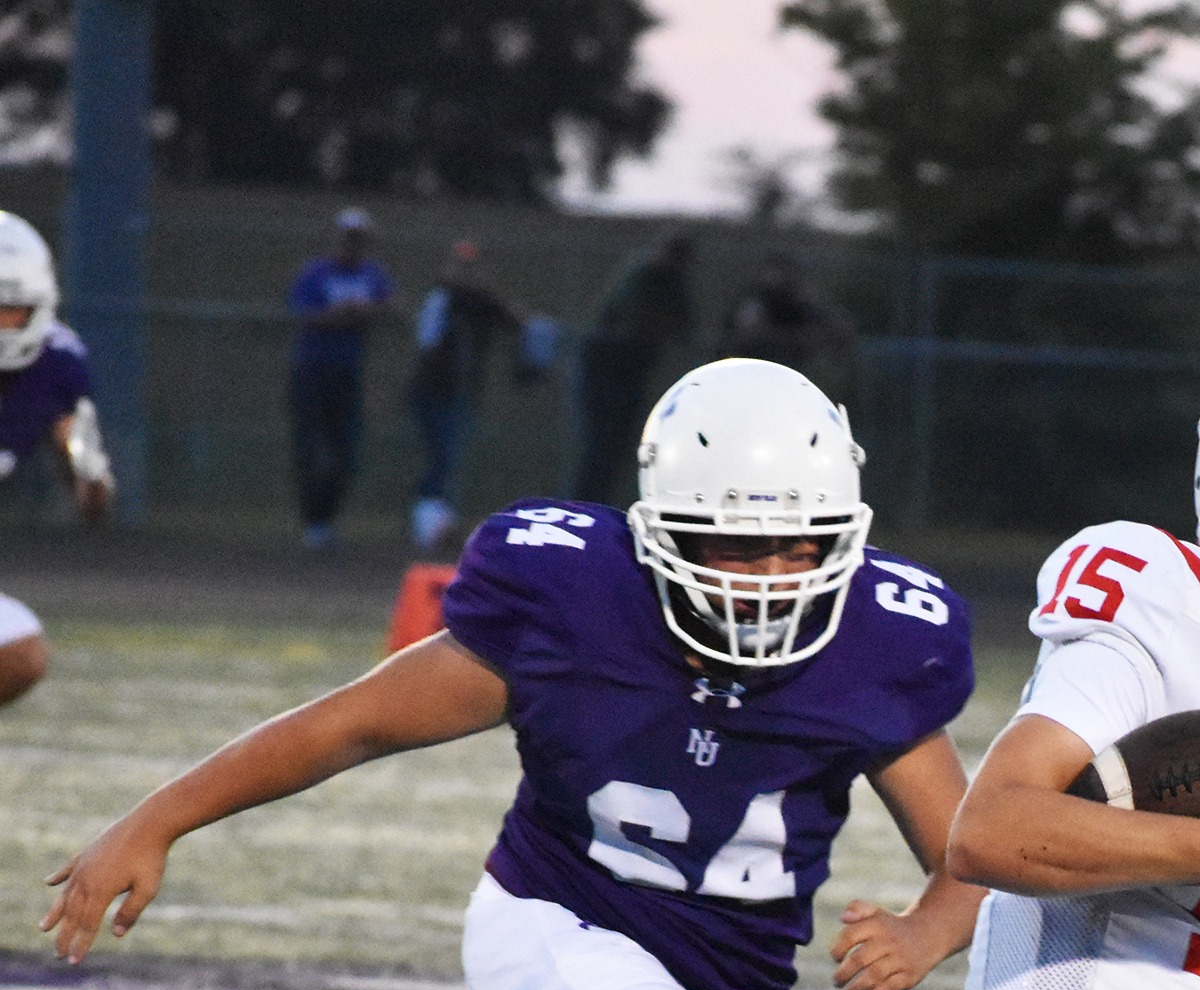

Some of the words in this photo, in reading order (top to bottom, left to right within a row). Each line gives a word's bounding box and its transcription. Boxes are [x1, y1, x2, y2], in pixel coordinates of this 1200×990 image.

[869, 558, 949, 627] 64
[1039, 544, 1149, 623] 15
[686, 728, 721, 768] NU
